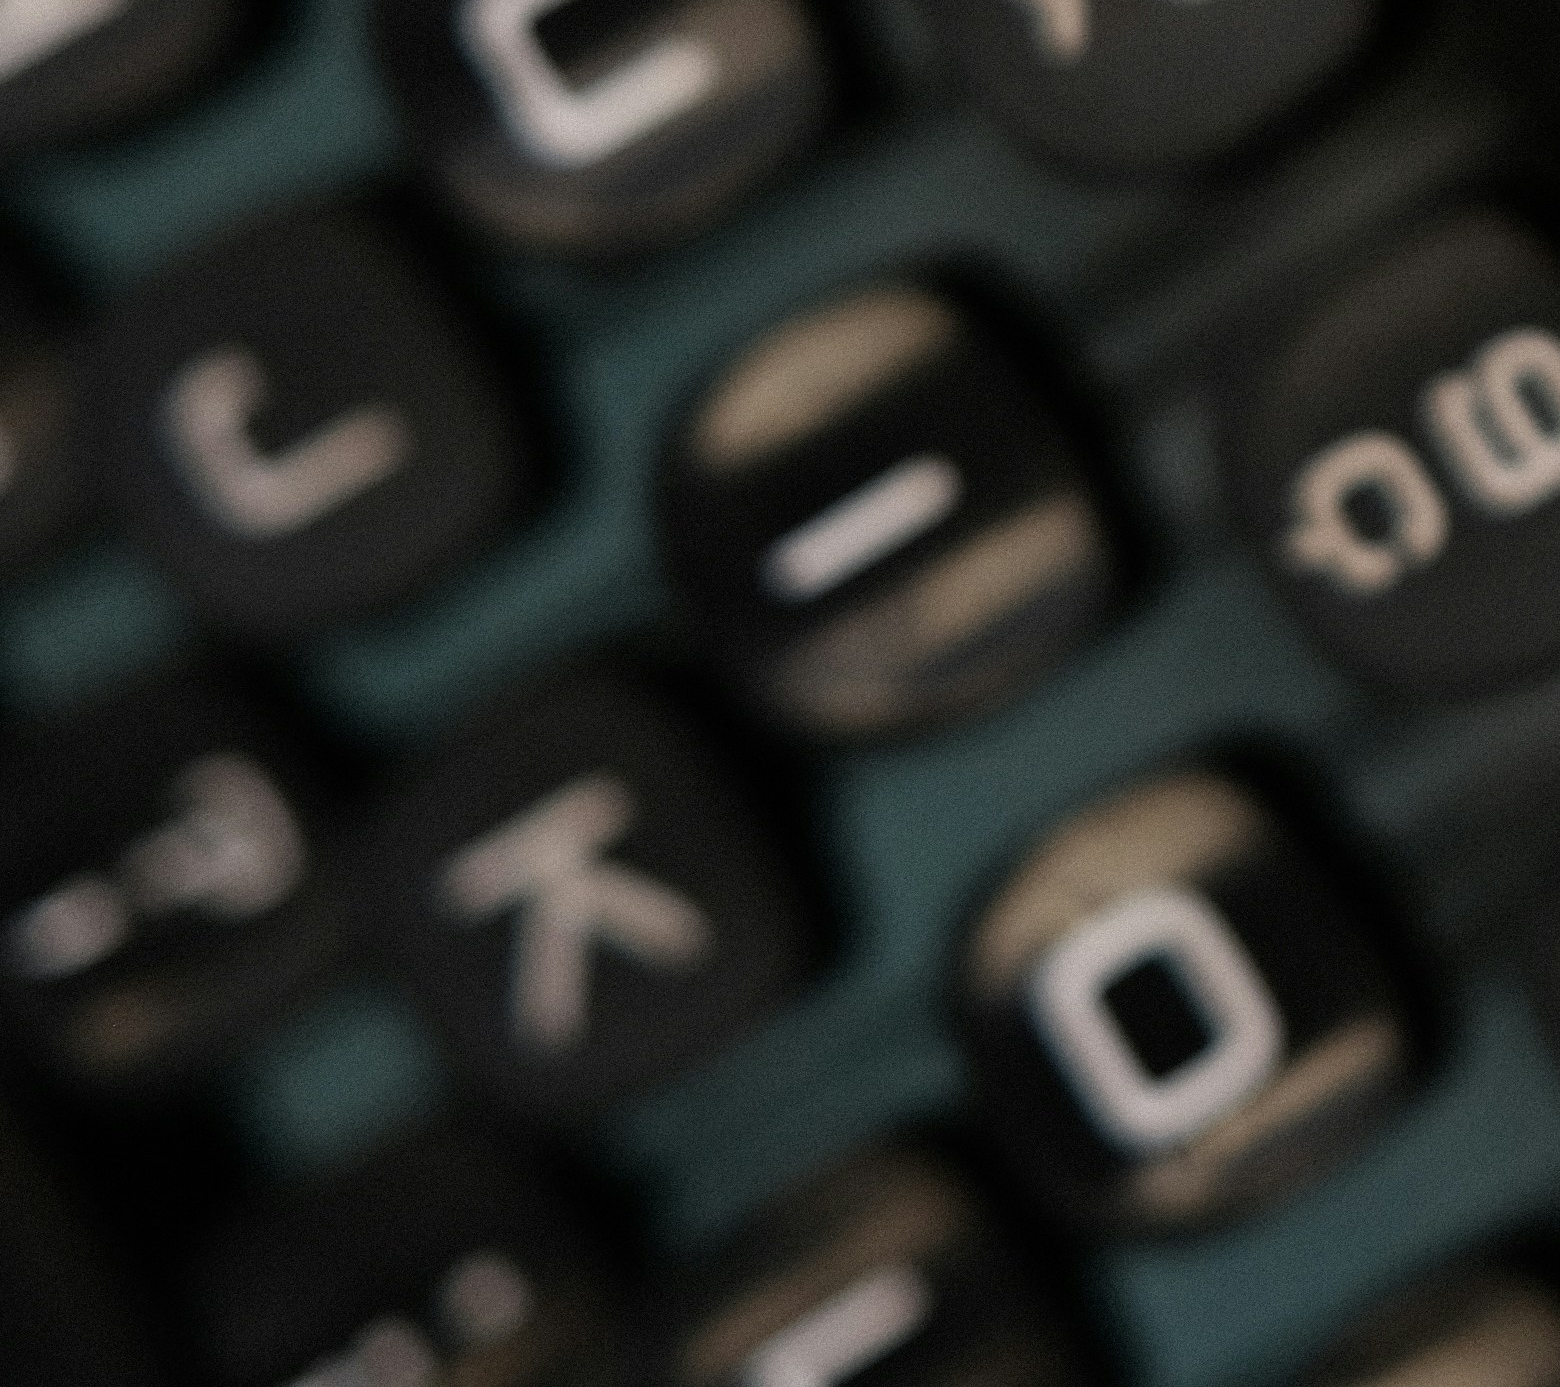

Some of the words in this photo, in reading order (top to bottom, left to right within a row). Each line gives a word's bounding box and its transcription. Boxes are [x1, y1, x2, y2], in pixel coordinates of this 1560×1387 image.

[168, 357, 394, 537] J
[770, 461, 955, 595] I
[449, 785, 698, 1037] K
